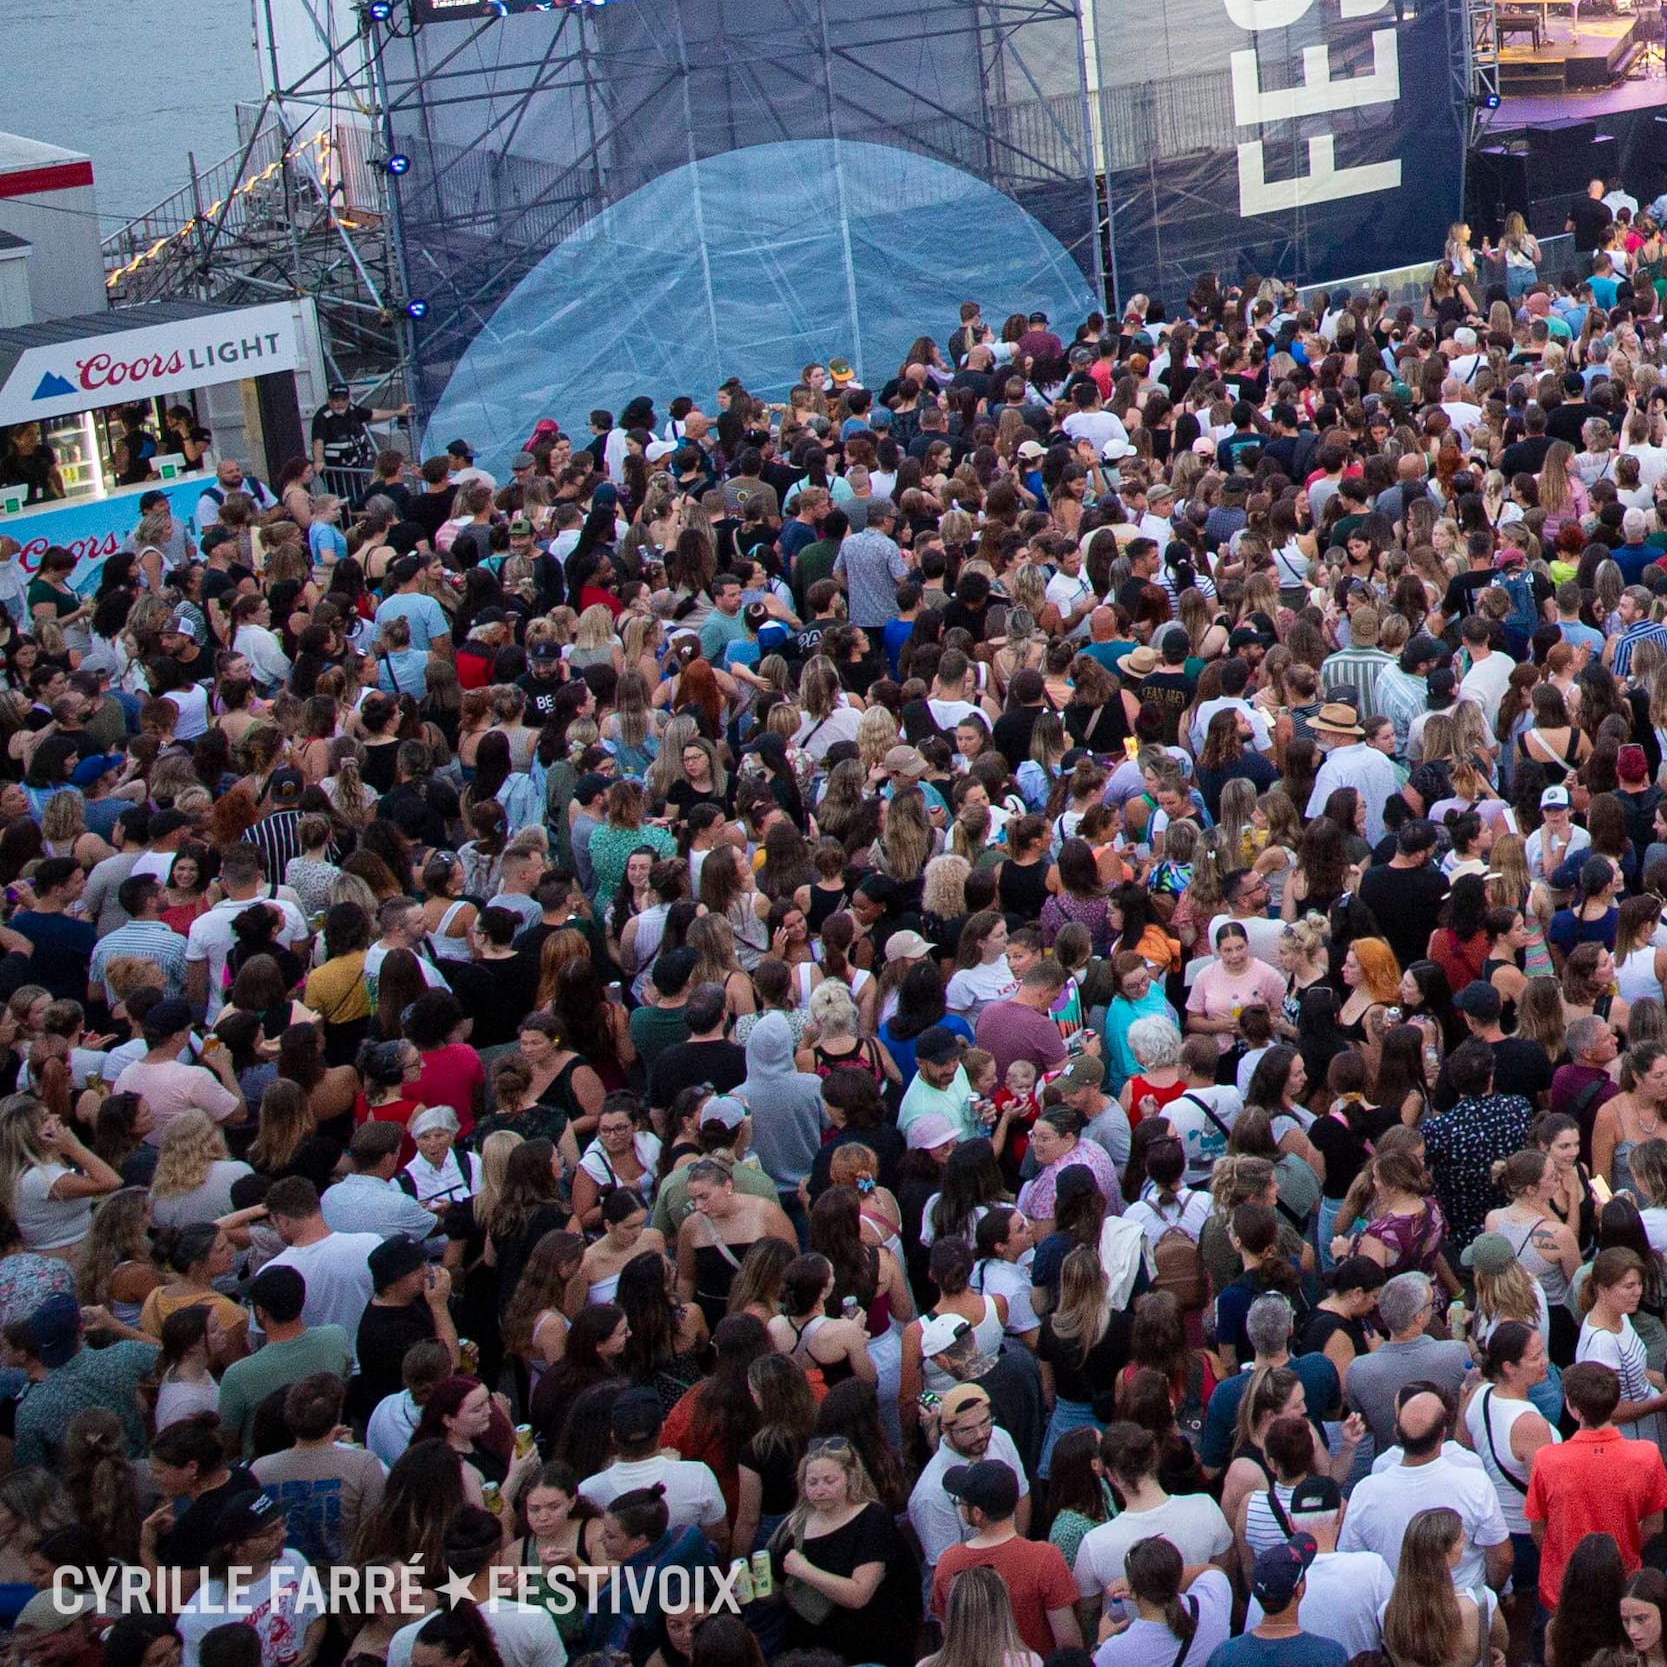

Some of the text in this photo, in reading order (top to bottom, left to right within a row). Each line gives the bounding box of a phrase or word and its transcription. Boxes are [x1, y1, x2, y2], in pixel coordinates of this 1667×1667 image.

[76, 333, 280, 390] Coors LIGHT
[18, 530, 120, 574] Cors
